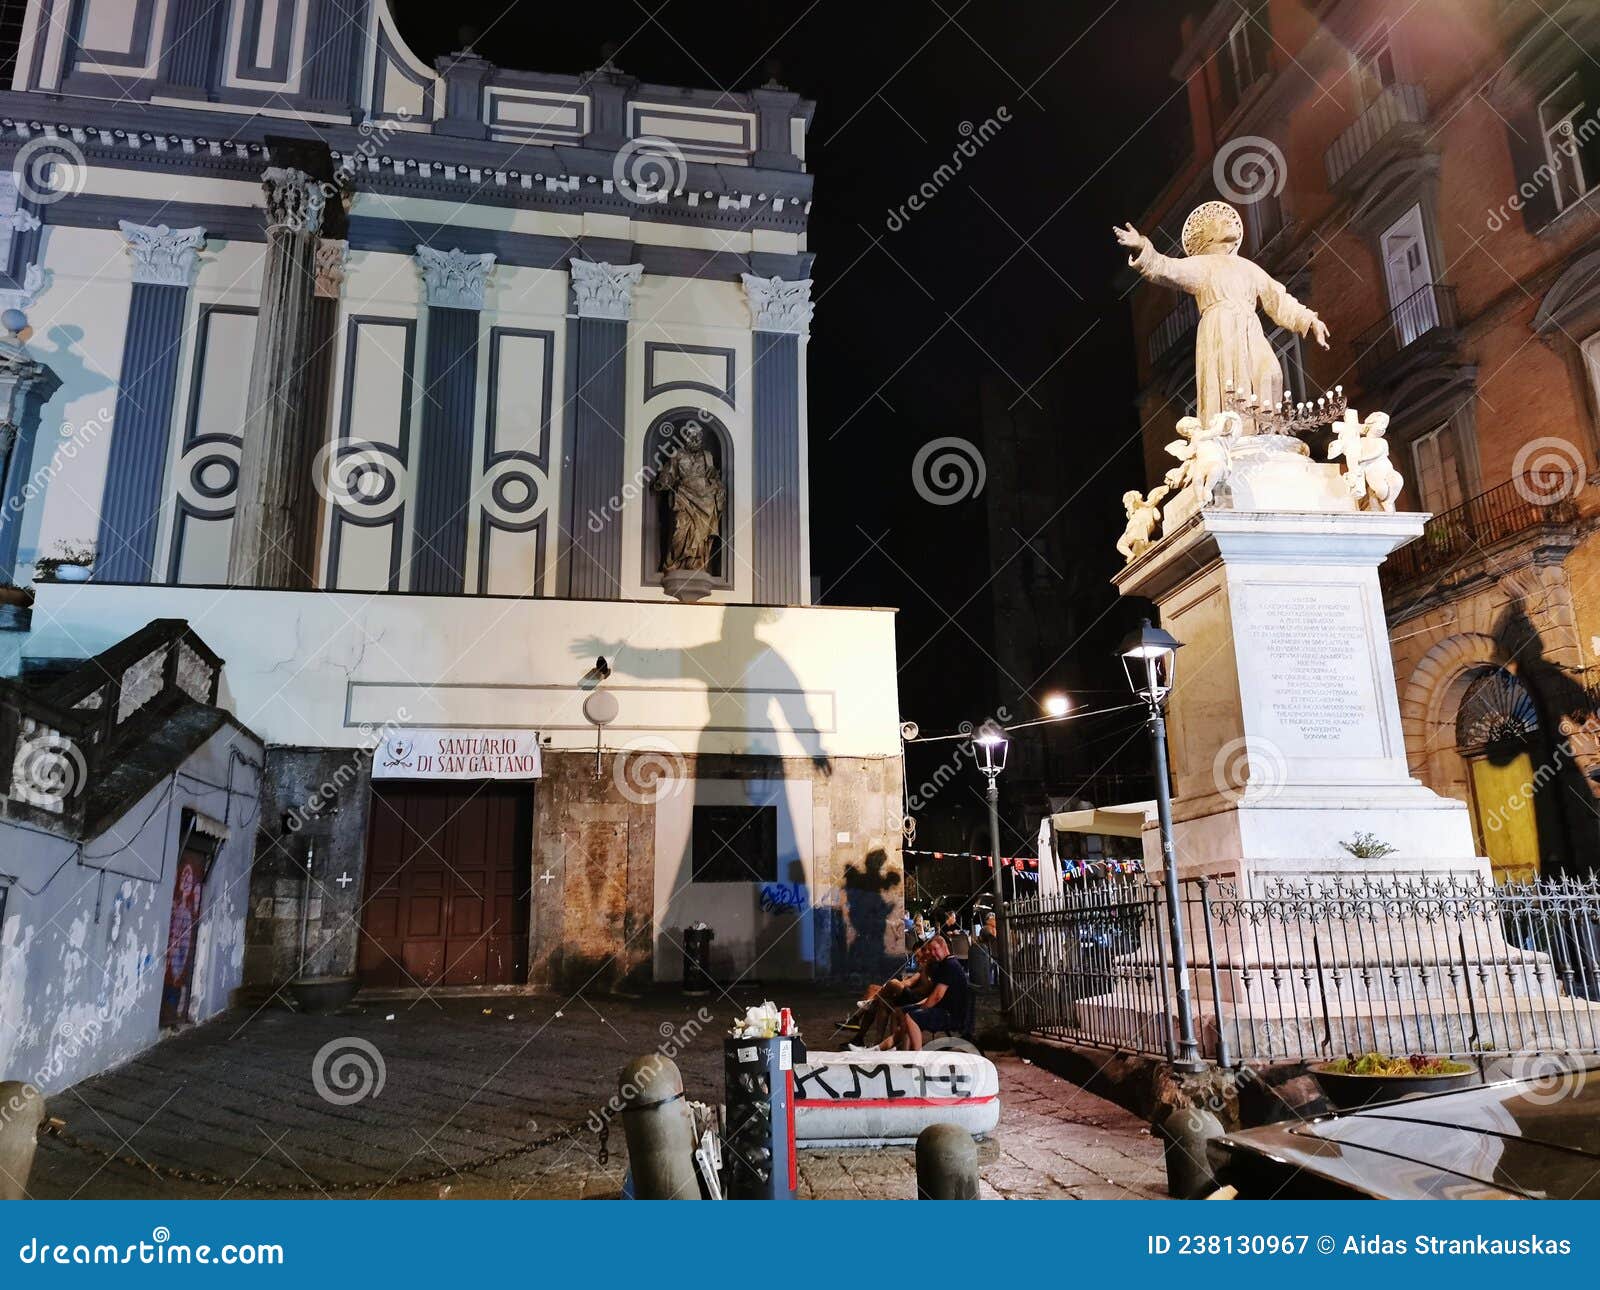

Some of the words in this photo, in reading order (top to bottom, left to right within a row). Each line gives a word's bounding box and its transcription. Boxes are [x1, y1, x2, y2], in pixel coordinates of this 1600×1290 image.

[438, 737, 516, 755] SANTUARIO
[417, 755, 432, 772] DI
[438, 756, 465, 773] SAN
[469, 755, 534, 773] GAETANO
